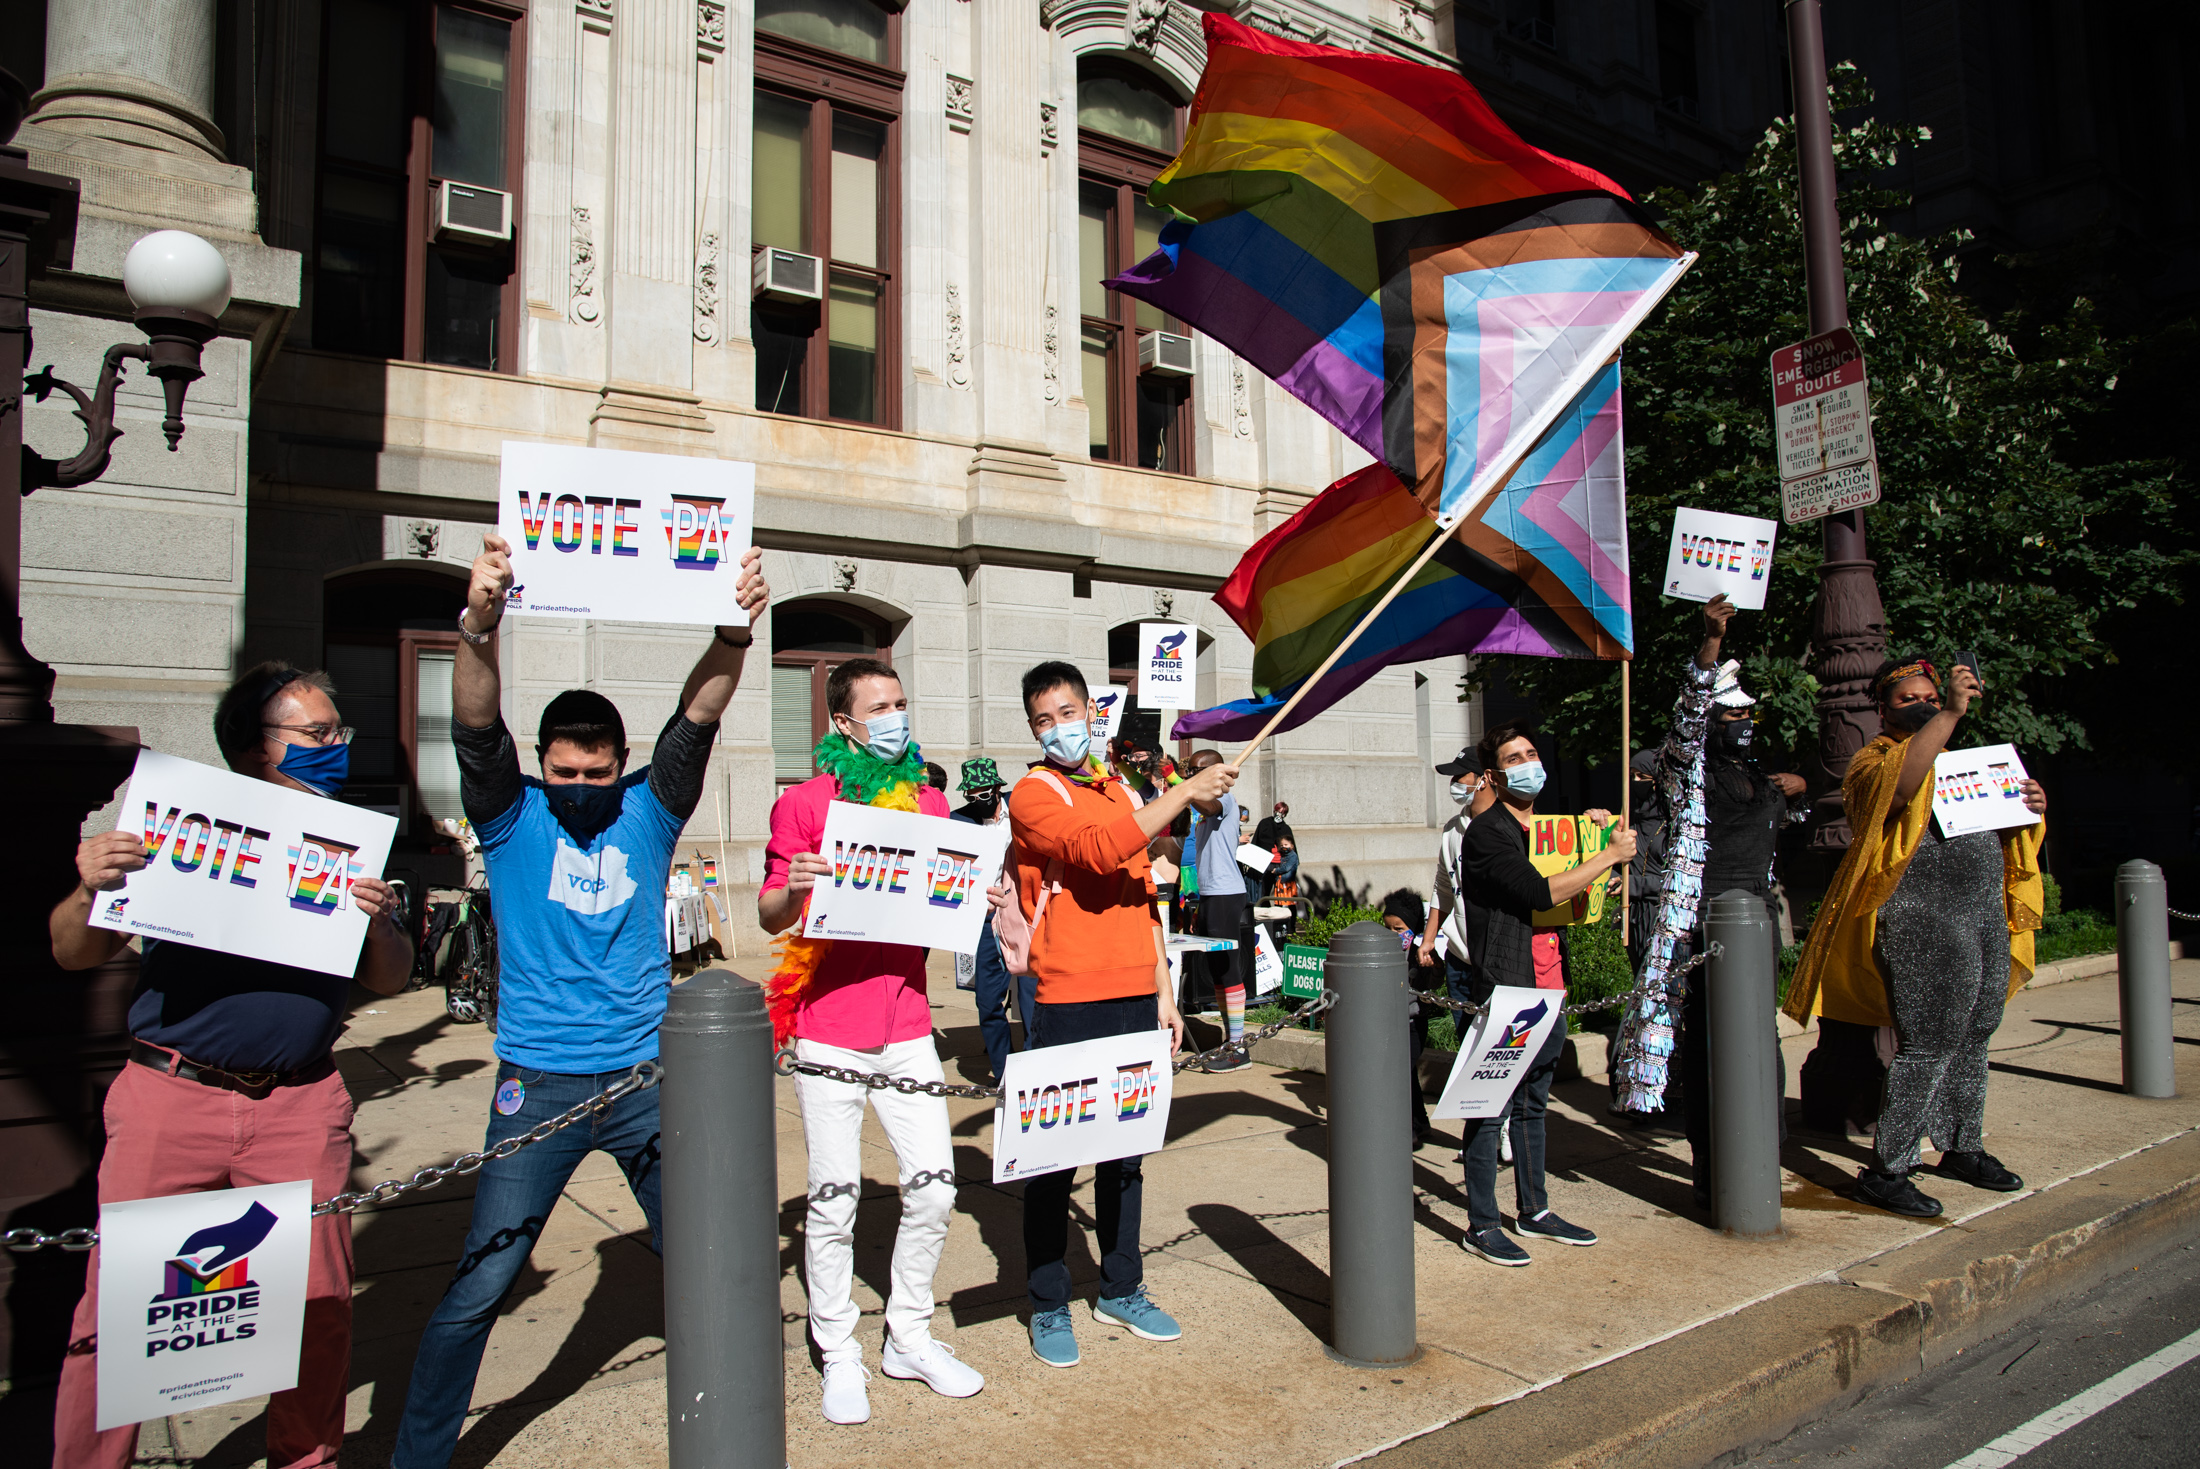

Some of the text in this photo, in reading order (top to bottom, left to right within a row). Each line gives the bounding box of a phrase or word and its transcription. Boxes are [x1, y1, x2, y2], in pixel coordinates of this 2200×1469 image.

[1793, 338, 1836, 363] SNOW
[1776, 347, 1857, 387] EMERGENCY
[1795, 370, 1842, 397] ROUTE
[1792, 402, 1811, 415] SNOW
[1838, 390, 1848, 401] OR
[1790, 410, 1815, 425] CHAINS
[1784, 430, 1794, 440] NO
[1790, 421, 1856, 448] DURING EMERGENCY
[1785, 434, 1864, 463] VEHICLES SUBJECT TO
[1788, 472, 1871, 503] INFORMATION
[1793, 465, 1862, 491] SNOW TOW
[1791, 482, 1870, 509] VEHICLE LOCATION
[518, 490, 729, 565] VOTE PA
[1681, 533, 1745, 573] VOTE
[530, 604, 591, 613] #prideatthepolls
[1151, 660, 1183, 669] PRIDE
[1151, 674, 1182, 682] POLLS
[1935, 764, 2020, 805] VOTE PA
[142, 801, 351, 911] VOTE PA
[834, 840, 973, 905] VOTE PA
[105, 909, 124, 917] PRIDE
[130, 920, 195, 938] #prideatthepolls
[1288, 954, 1327, 972] PLEASE K
[1293, 974, 1314, 990] DOGS
[1483, 1049, 1525, 1062] PRIDE
[1470, 1069, 1511, 1080] POLLS
[1018, 1066, 1154, 1134] VOTE PA
[146, 1290, 261, 1326] PRIDE
[171, 1313, 236, 1334] AT THE
[146, 1322, 257, 1358] POLLS
[158, 1371, 244, 1395] #prideatthepolls
[170, 1383, 232, 1402] #civicbooty
